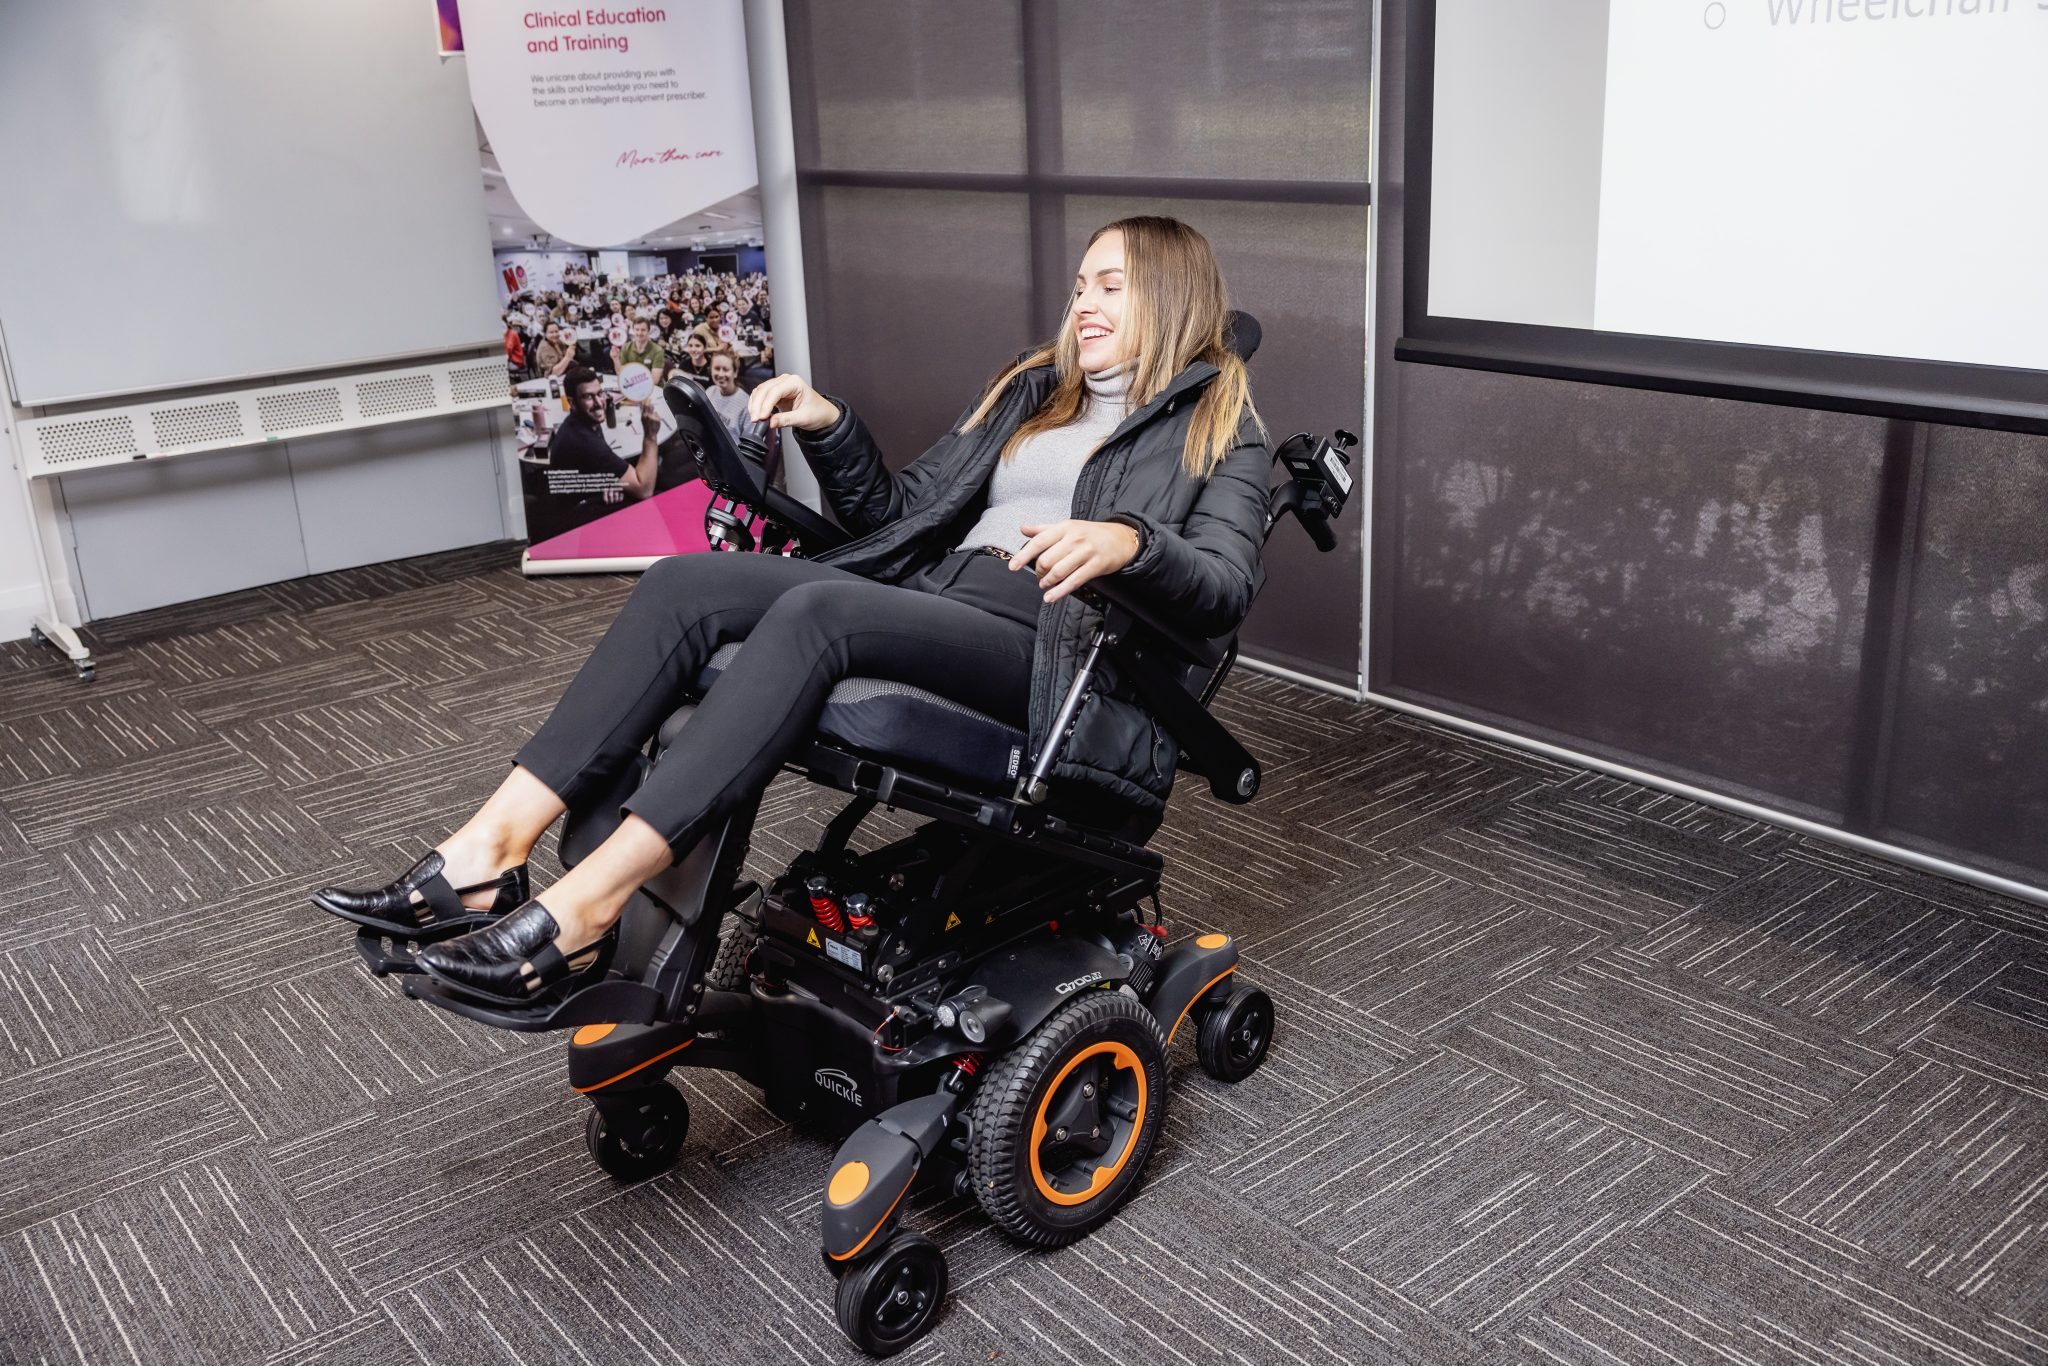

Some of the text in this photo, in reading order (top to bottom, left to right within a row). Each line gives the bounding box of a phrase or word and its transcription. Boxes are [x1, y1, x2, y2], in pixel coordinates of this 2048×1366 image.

[524, 7, 666, 28] Clinical Education
[527, 33, 628, 53] and Training
[577, 71, 602, 81] about
[603, 69, 641, 81] providing
[643, 70, 658, 79] you
[659, 68, 676, 76] with
[532, 86, 545, 95] the
[568, 84, 584, 93] and
[585, 82, 631, 93] knowledge
[632, 83, 648, 92] you
[649, 80, 669, 89] need
[670, 80, 679, 88] to
[534, 98, 567, 107] become
[621, 93, 665, 104] equipment
[615, 148, 723, 168] More than care
[1011, 749, 1021, 776] SEDEO
[814, 1071, 863, 1107] QUICKIE
